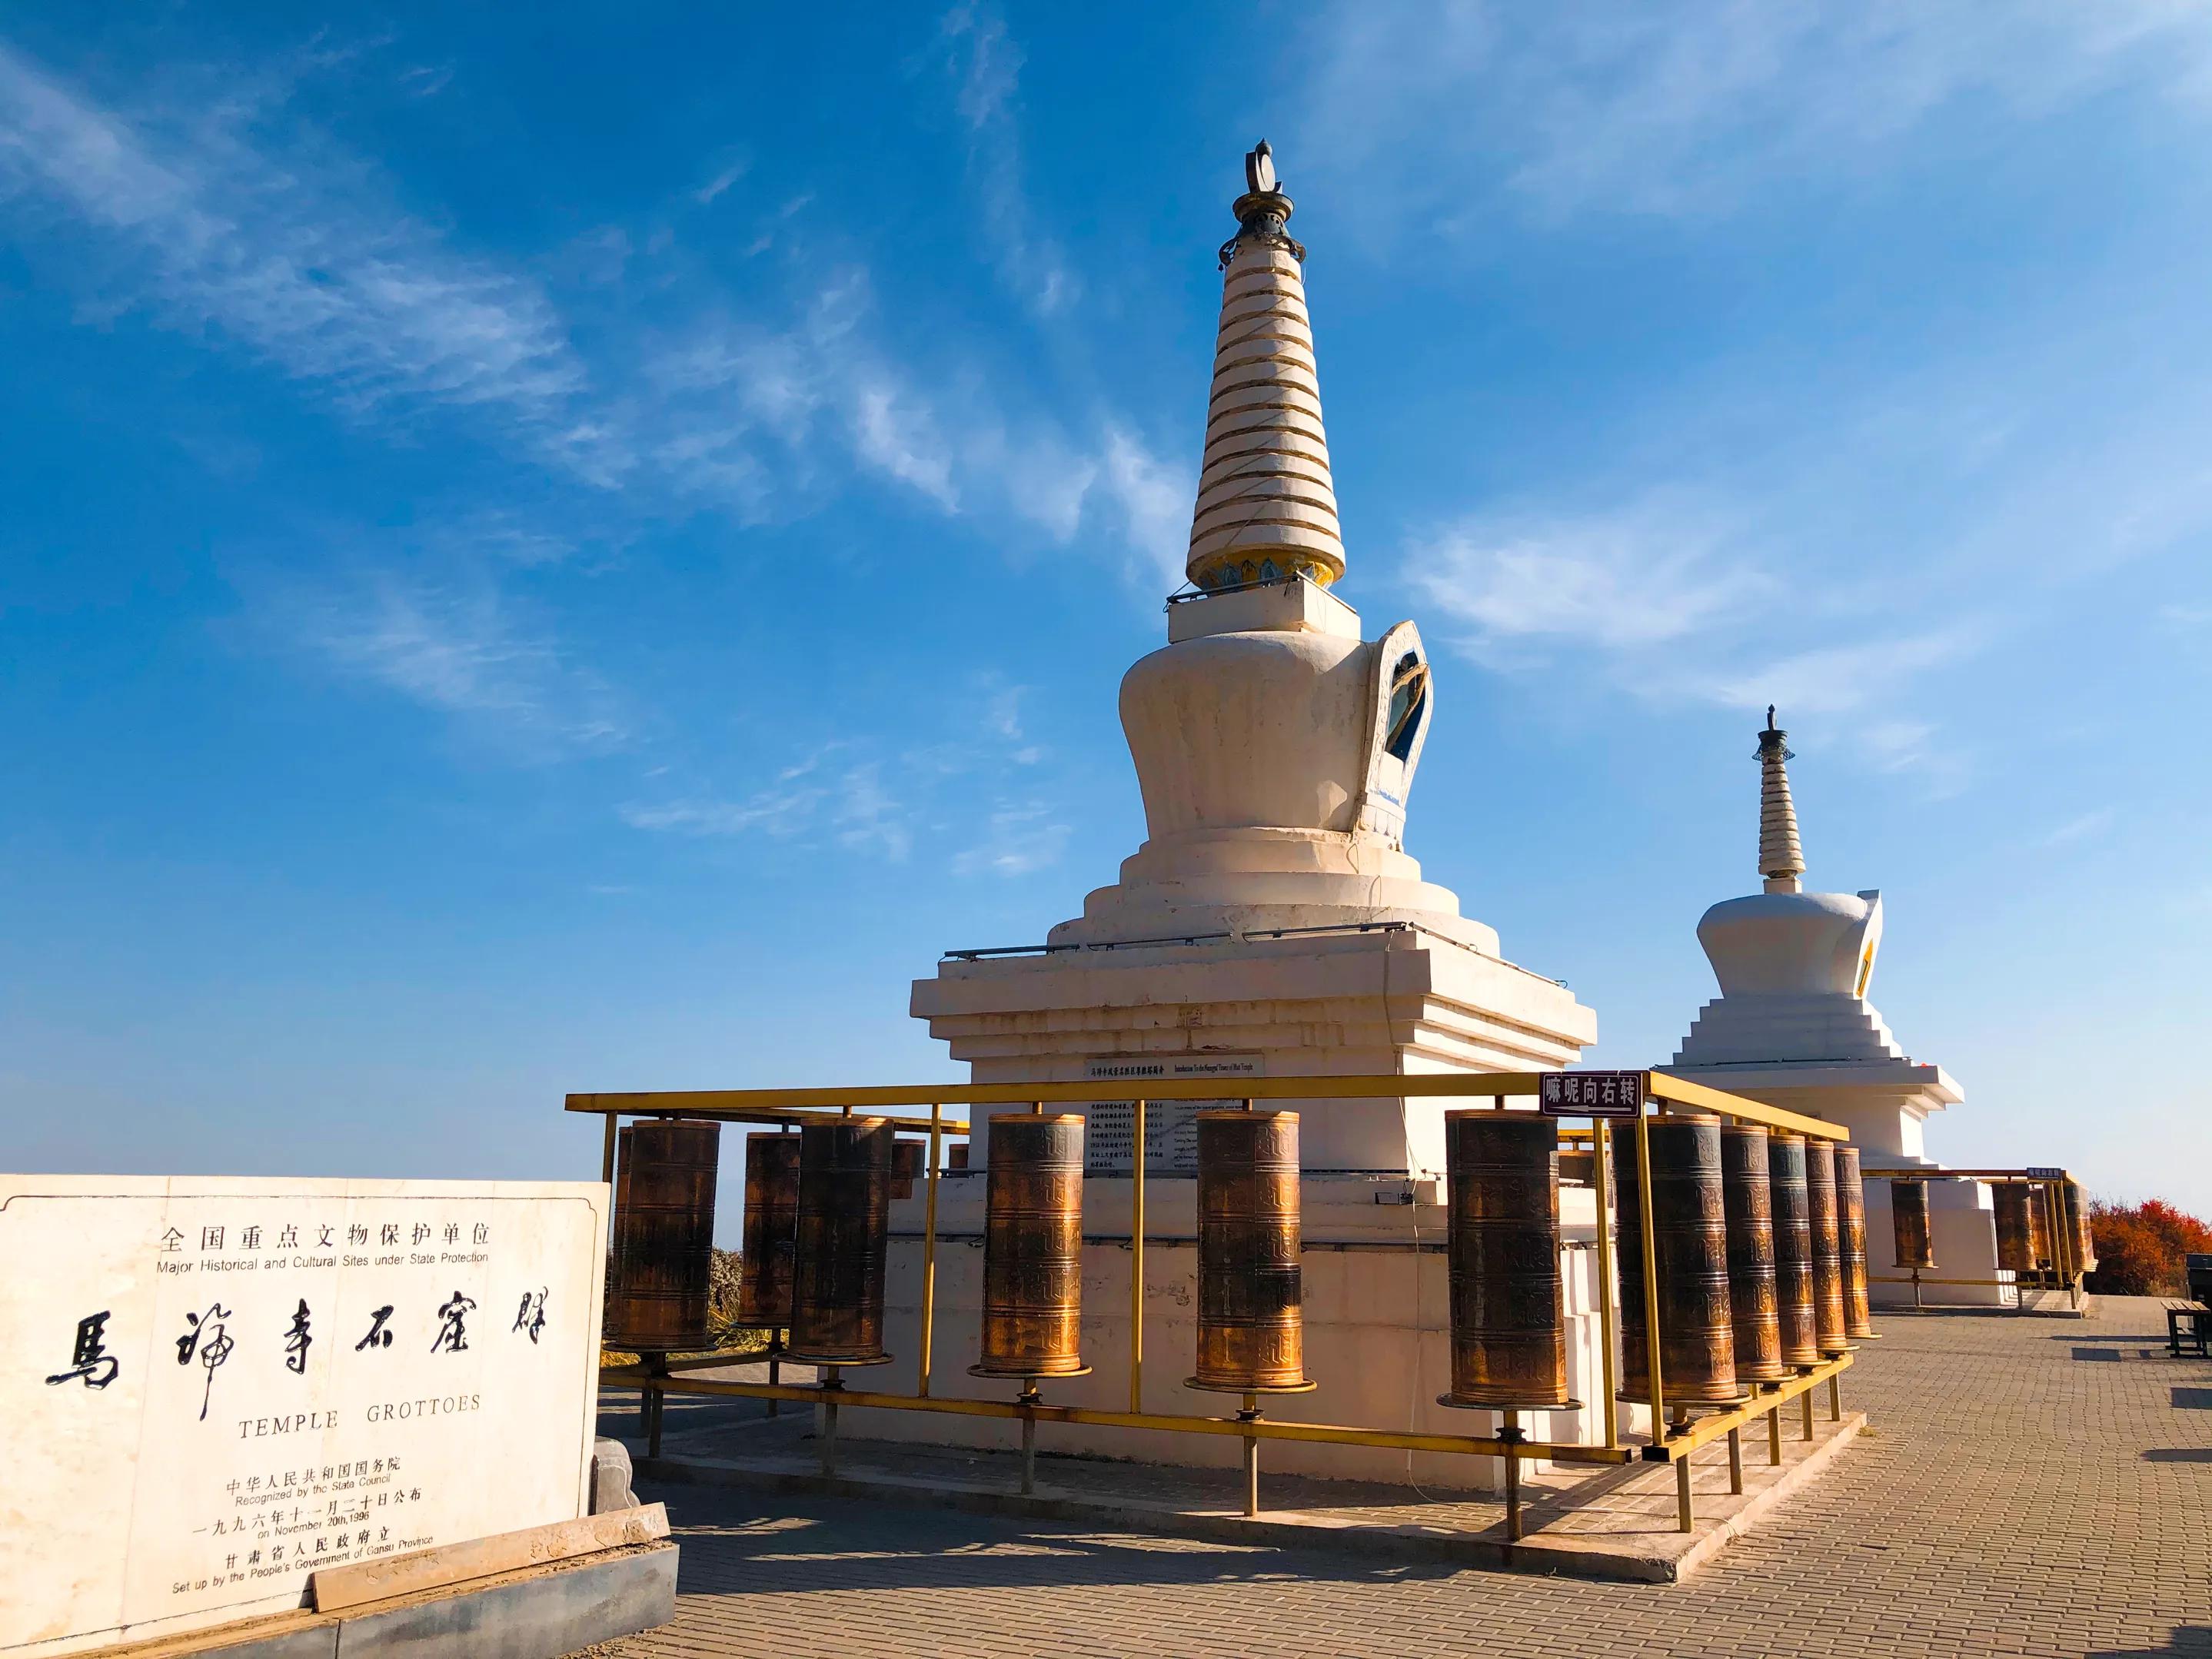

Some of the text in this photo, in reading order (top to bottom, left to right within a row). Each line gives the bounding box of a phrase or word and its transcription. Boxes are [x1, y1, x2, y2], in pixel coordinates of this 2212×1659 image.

[1545, 1076, 1635, 1105] 嘛呢向右转
[161, 1222, 490, 1252] 全国重点文物保护单位
[156, 1251, 488, 1276] Major Historical and Cultural Sites under State Protection
[239, 1394, 482, 1439] TEMPLE GROTTOES
[226, 1456, 401, 1496] 中华人民共和国国务院
[235, 1488, 292, 1507] Recognized
[297, 1487, 308, 1498] by
[331, 1478, 354, 1491] State
[359, 1473, 391, 1487] Council
[192, 1487, 422, 1536] 一九九六年十一月二十日公布
[225, 1525, 390, 1569] 甘肃省人民政府立
[258, 1530, 270, 1539] on
[172, 1535, 433, 1594] Set up by the People's Government of Gansu Province
